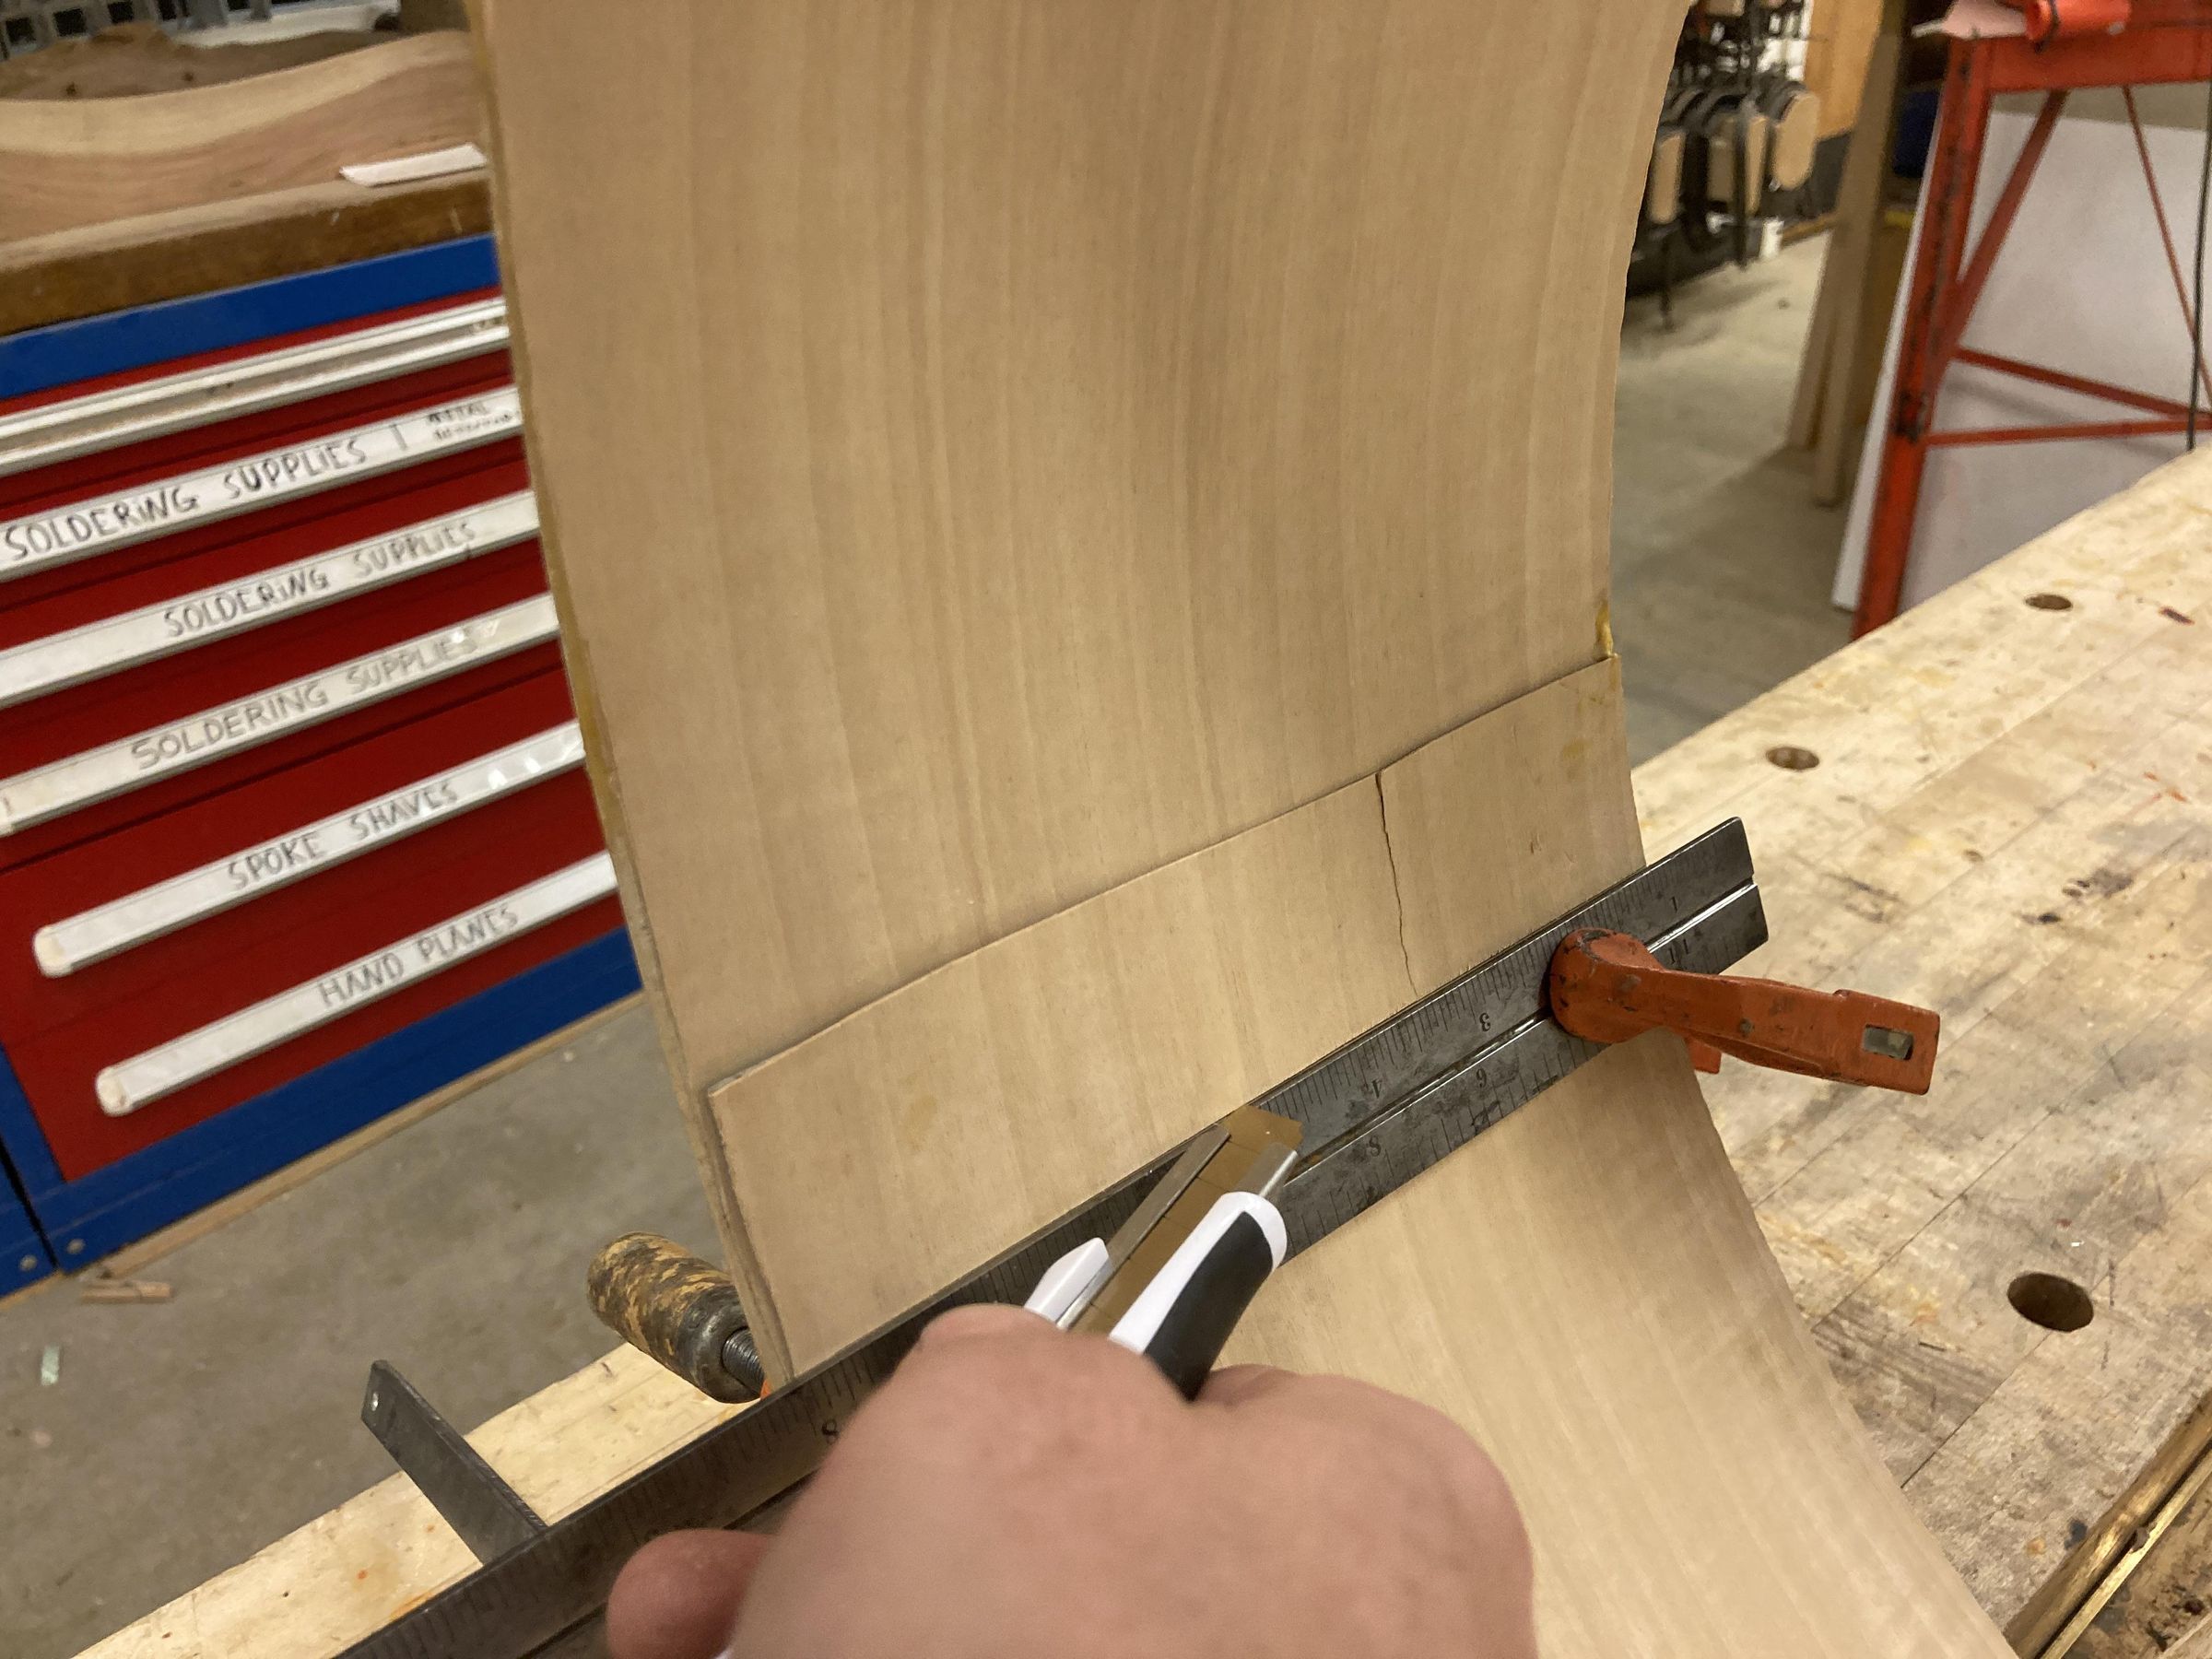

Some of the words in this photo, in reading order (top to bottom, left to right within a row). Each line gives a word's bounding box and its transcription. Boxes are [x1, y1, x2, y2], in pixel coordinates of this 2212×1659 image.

[5, 485, 198, 560] SOLDERING
[223, 436, 367, 499] SUPPLIES
[164, 569, 330, 638] SOLDERING
[353, 522, 476, 578] SUPPLIES
[131, 681, 328, 770] SOLDERING
[228, 831, 324, 889] SPOKE
[350, 781, 457, 841] SHAVES
[319, 952, 405, 1006] HAND
[417, 903, 518, 962] PLANES
[1479, 1012, 1491, 1032] 3
